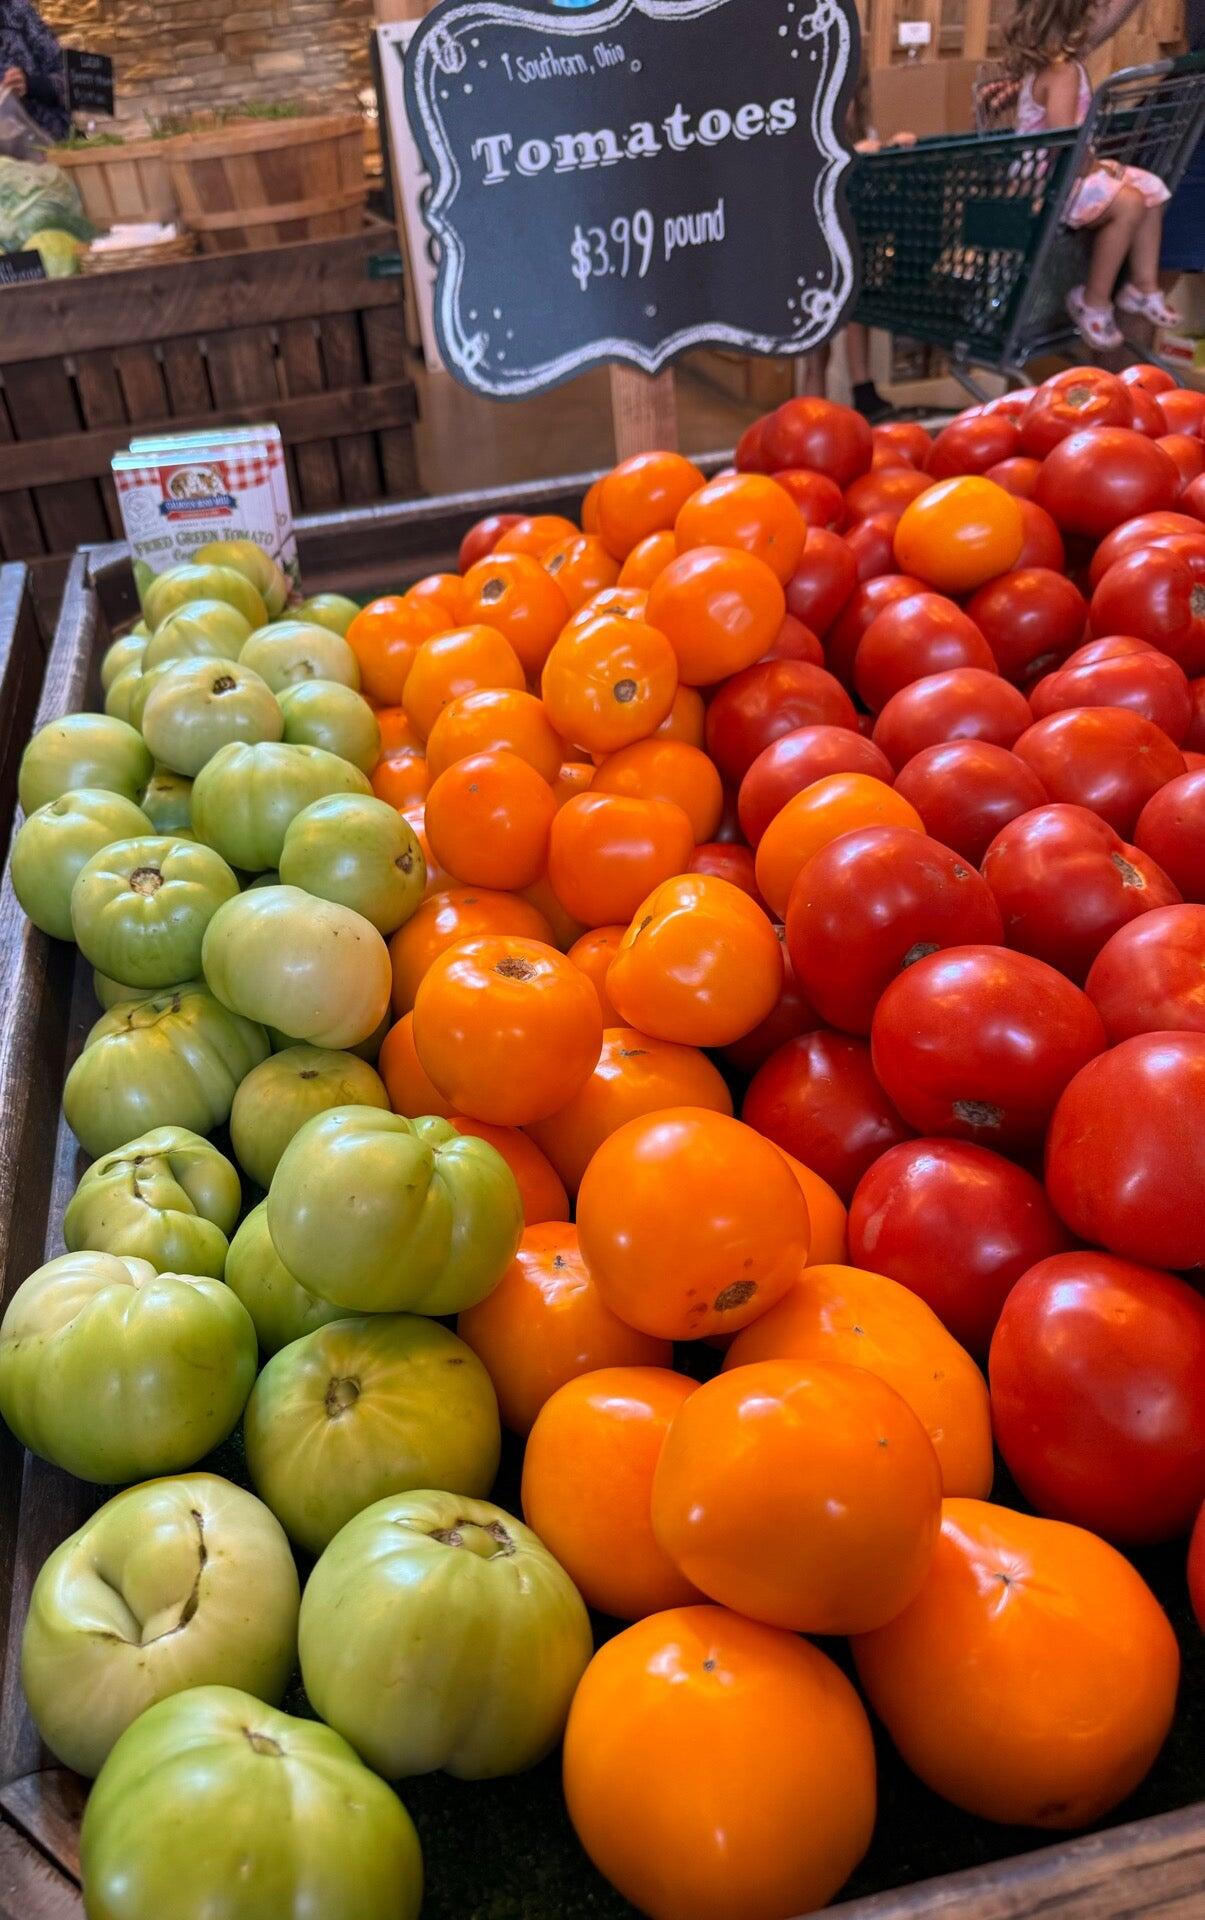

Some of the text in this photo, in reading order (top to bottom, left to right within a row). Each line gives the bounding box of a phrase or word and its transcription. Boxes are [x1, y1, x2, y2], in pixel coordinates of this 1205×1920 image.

[515, 46, 596, 84] Southern,
[592, 41, 626, 69] Ohio
[471, 97, 797, 185] Tomatoes
[570, 197, 726, 292] $3.99 pound
